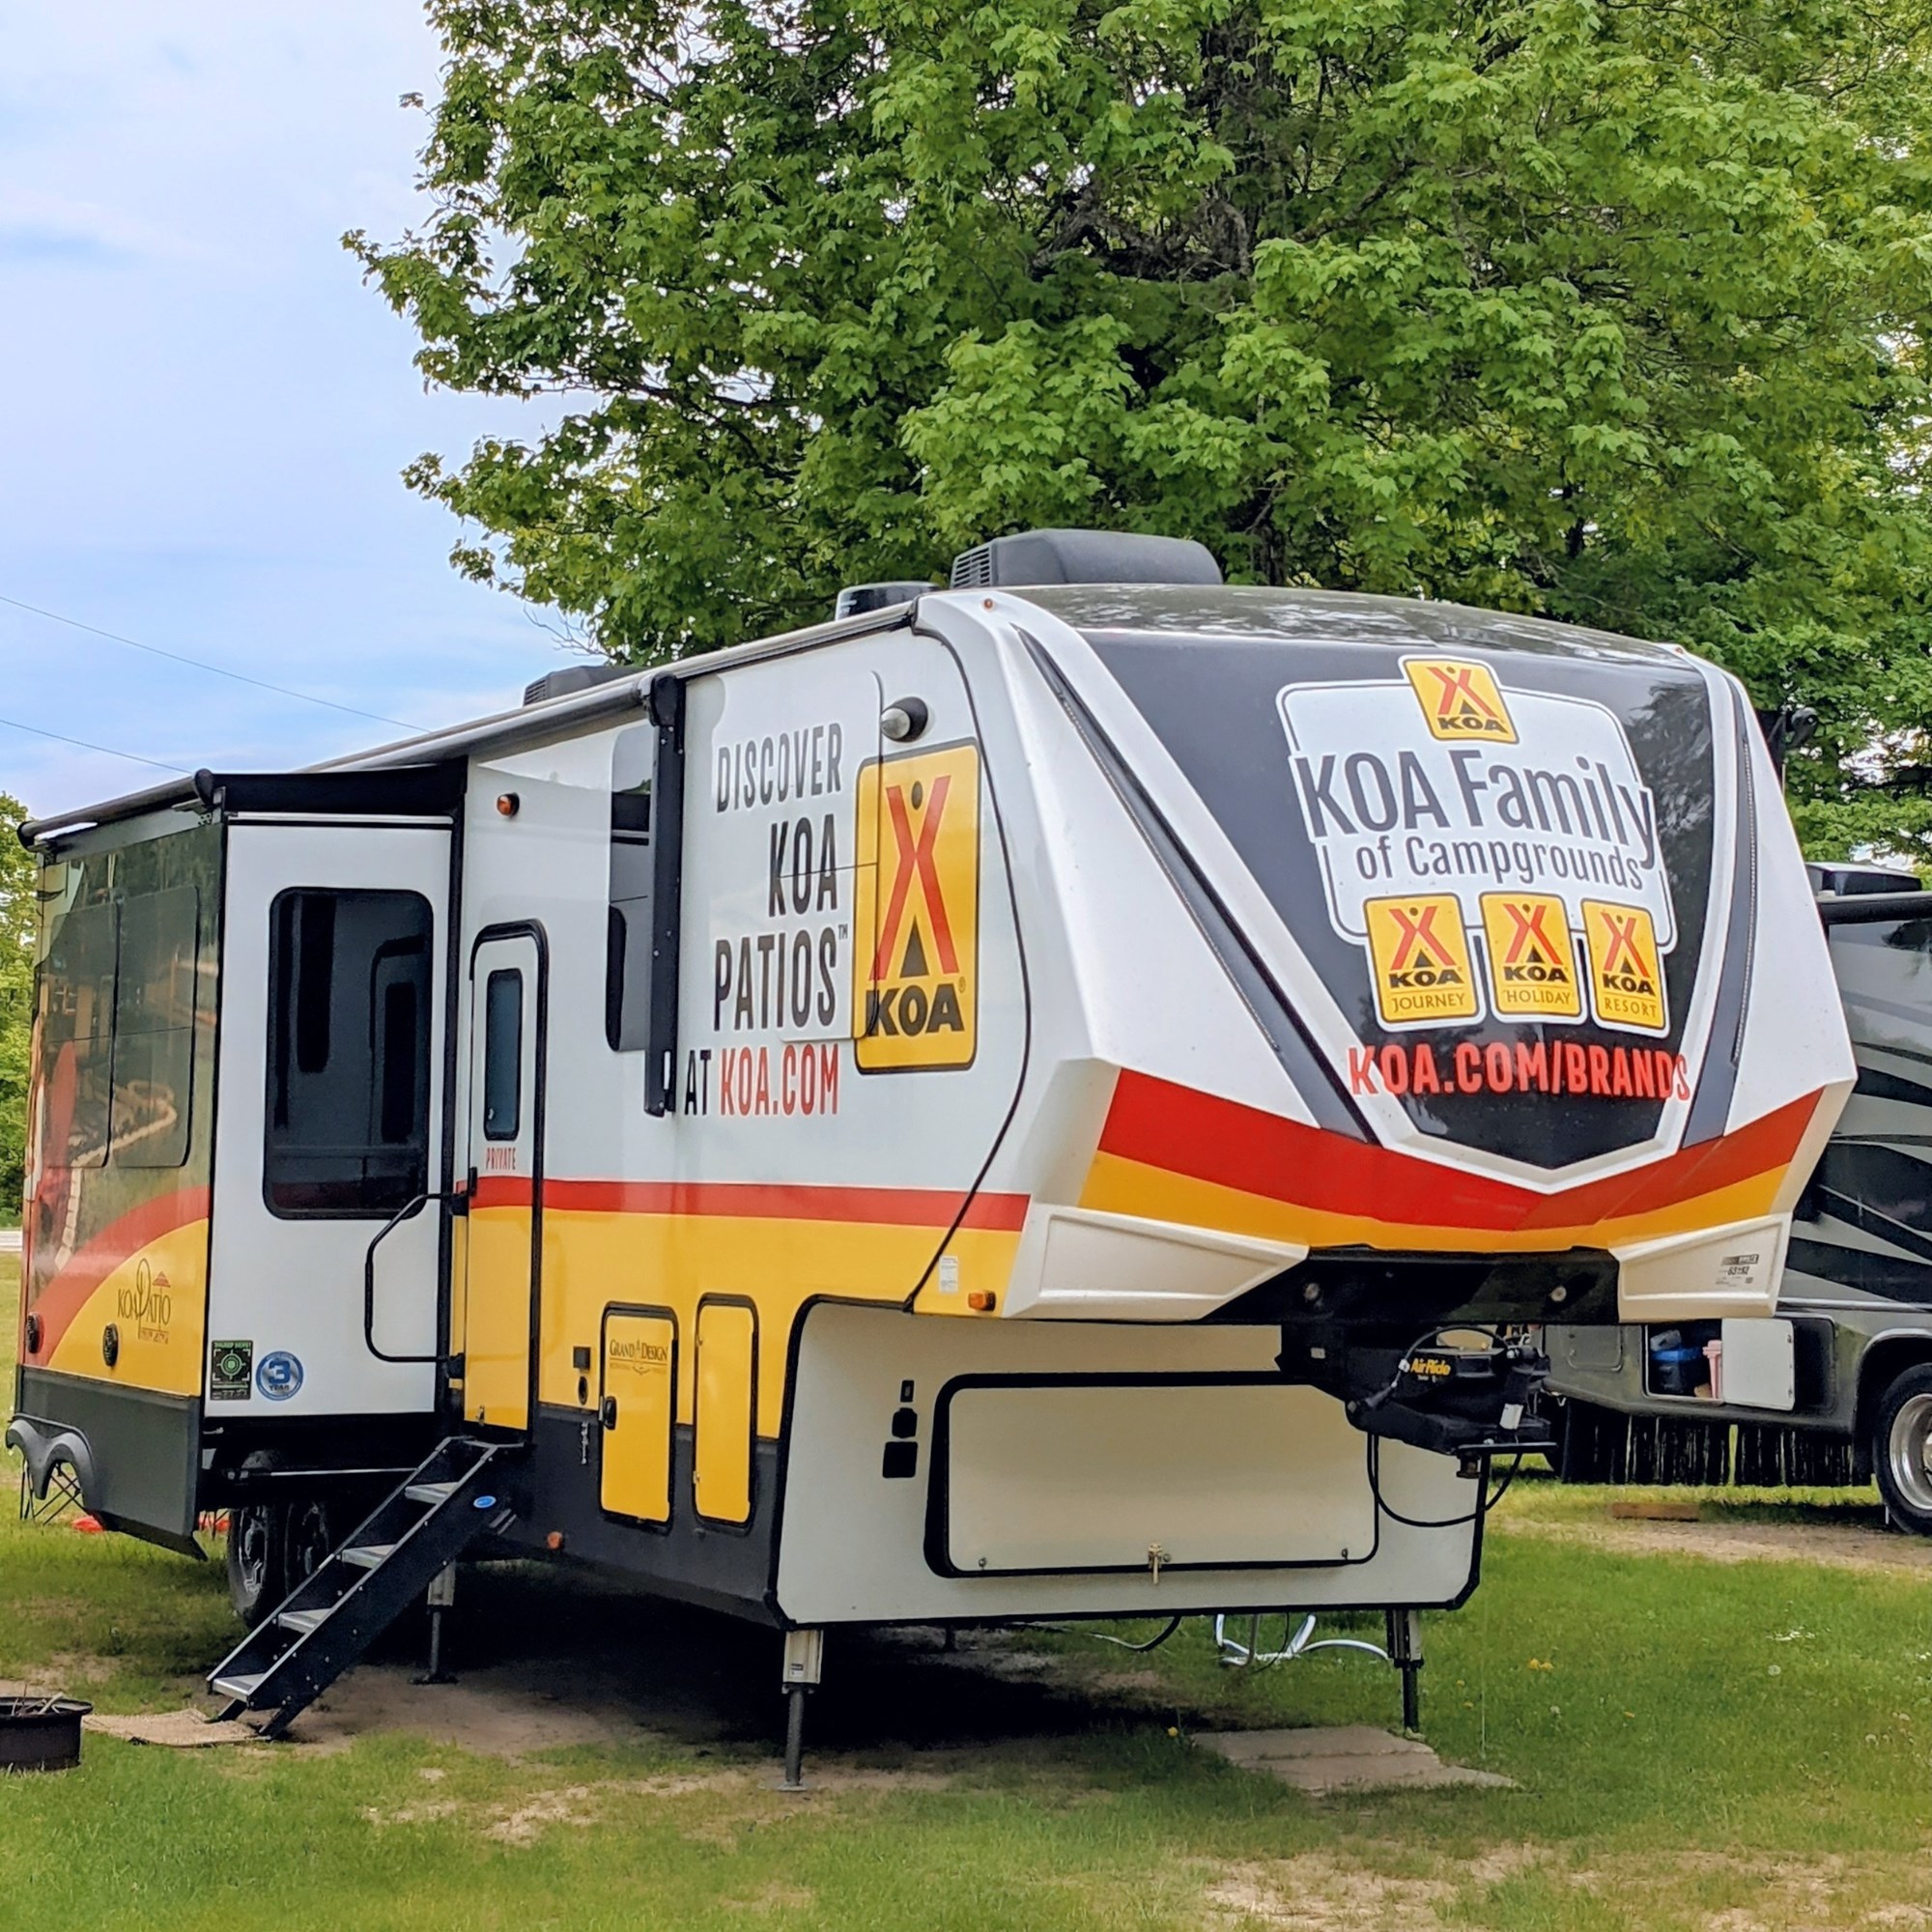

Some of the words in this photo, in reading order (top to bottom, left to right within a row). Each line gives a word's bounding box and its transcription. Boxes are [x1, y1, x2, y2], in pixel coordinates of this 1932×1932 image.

[1437, 716, 1508, 734] KOA
[717, 723, 841, 812] DISCOVER
[1294, 751, 1451, 838] KOA
[1448, 750, 1655, 869] Family
[769, 813, 838, 917] KOA
[1356, 836, 1392, 880] of
[1406, 836, 1644, 891] Campgrounds
[1389, 969, 1464, 988] KOA
[1504, 965, 1570, 983] KOA
[1603, 974, 1656, 997] KOA
[1391, 992, 1465, 1012] JOURNEY
[1506, 989, 1572, 1007] HOLIDAY
[1604, 997, 1658, 1019] RESORT
[685, 1049, 712, 1116] AT
[720, 1043, 838, 1116] KOA.COM
[1349, 1040, 1690, 1101] KOA.COM/BRANDS
[486, 1148, 516, 1170] PRIVATE
[610, 1339, 635, 1358] GRAND
[269, 1360, 291, 1384] 3
